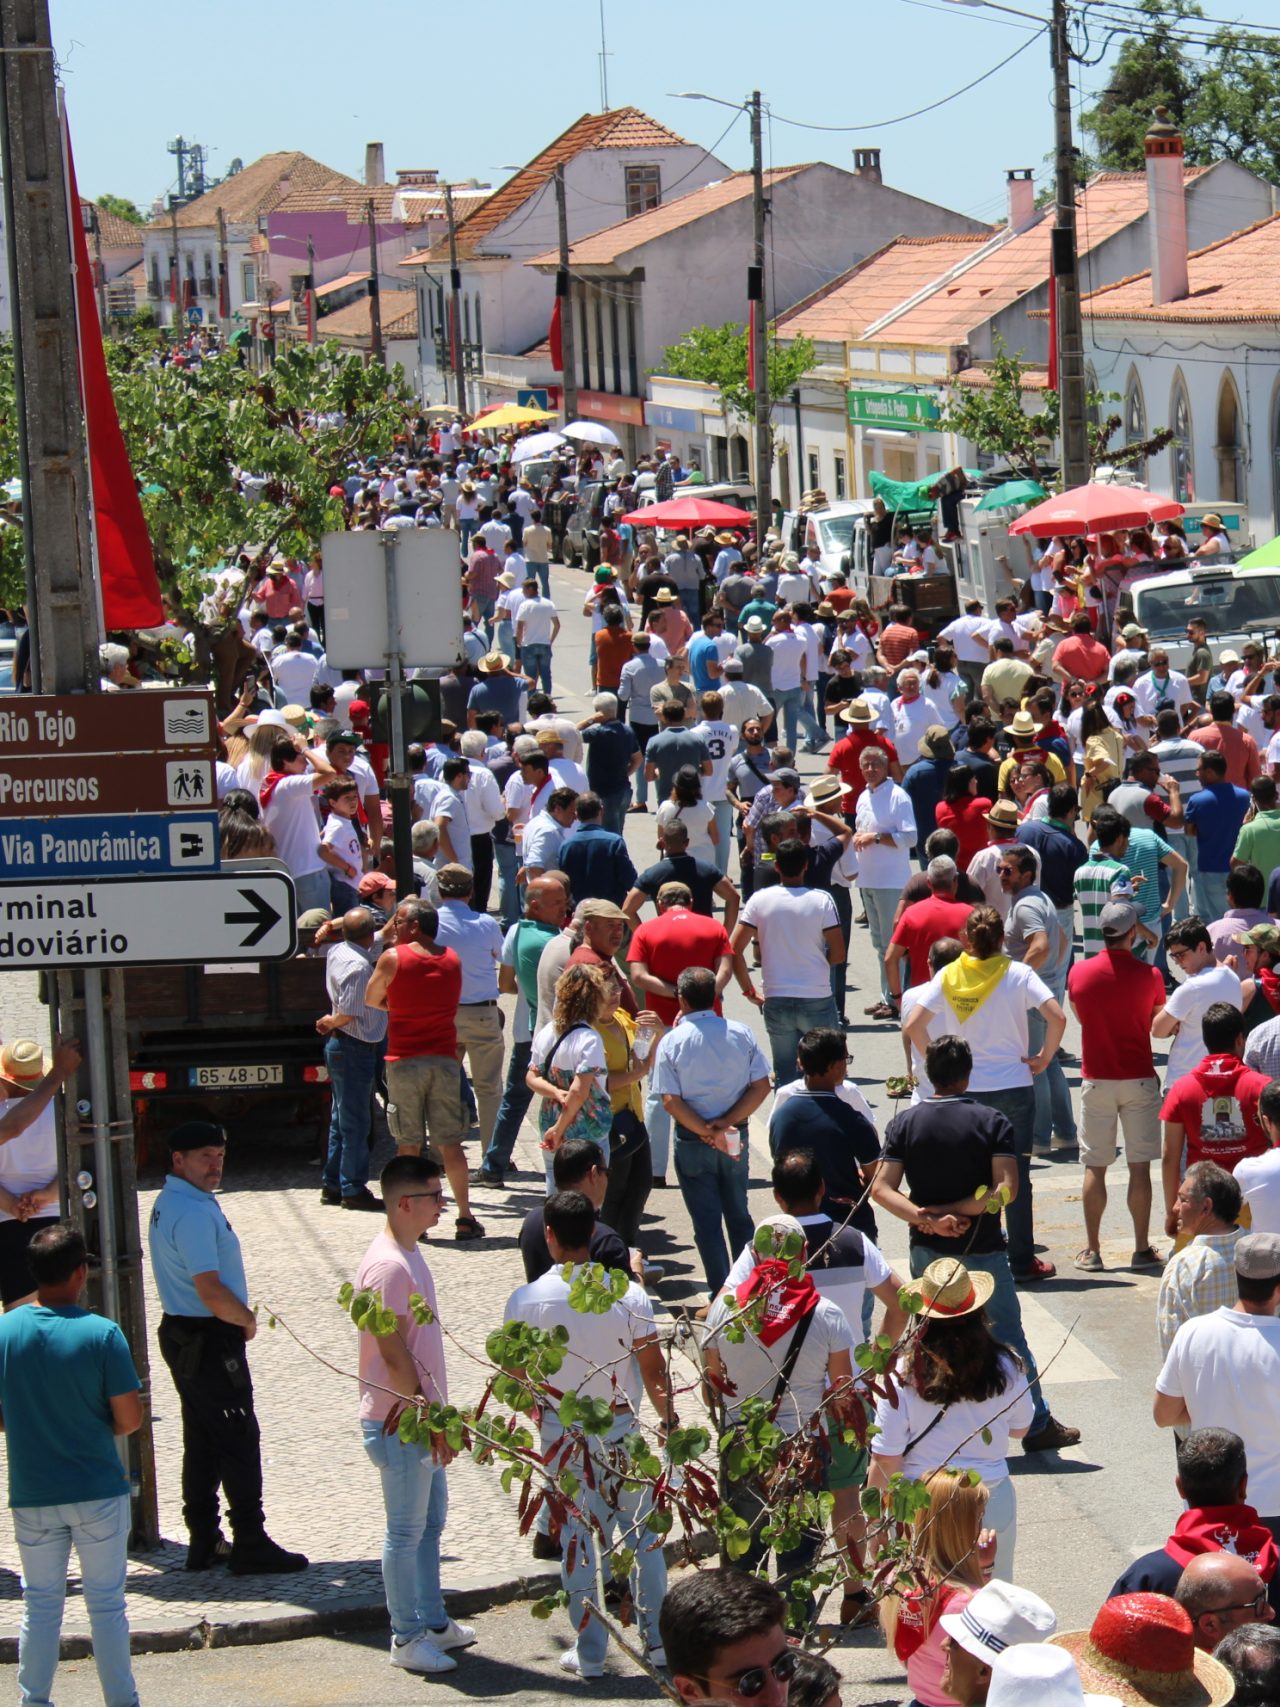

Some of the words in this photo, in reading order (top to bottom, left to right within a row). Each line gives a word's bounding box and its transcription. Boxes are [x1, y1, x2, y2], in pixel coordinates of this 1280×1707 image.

[0, 711, 29, 742] Rio
[34, 709, 76, 748] Tejo
[0, 773, 99, 804] Percursos
[1, 834, 35, 865] Via
[41, 830, 161, 864] Panorâmica
